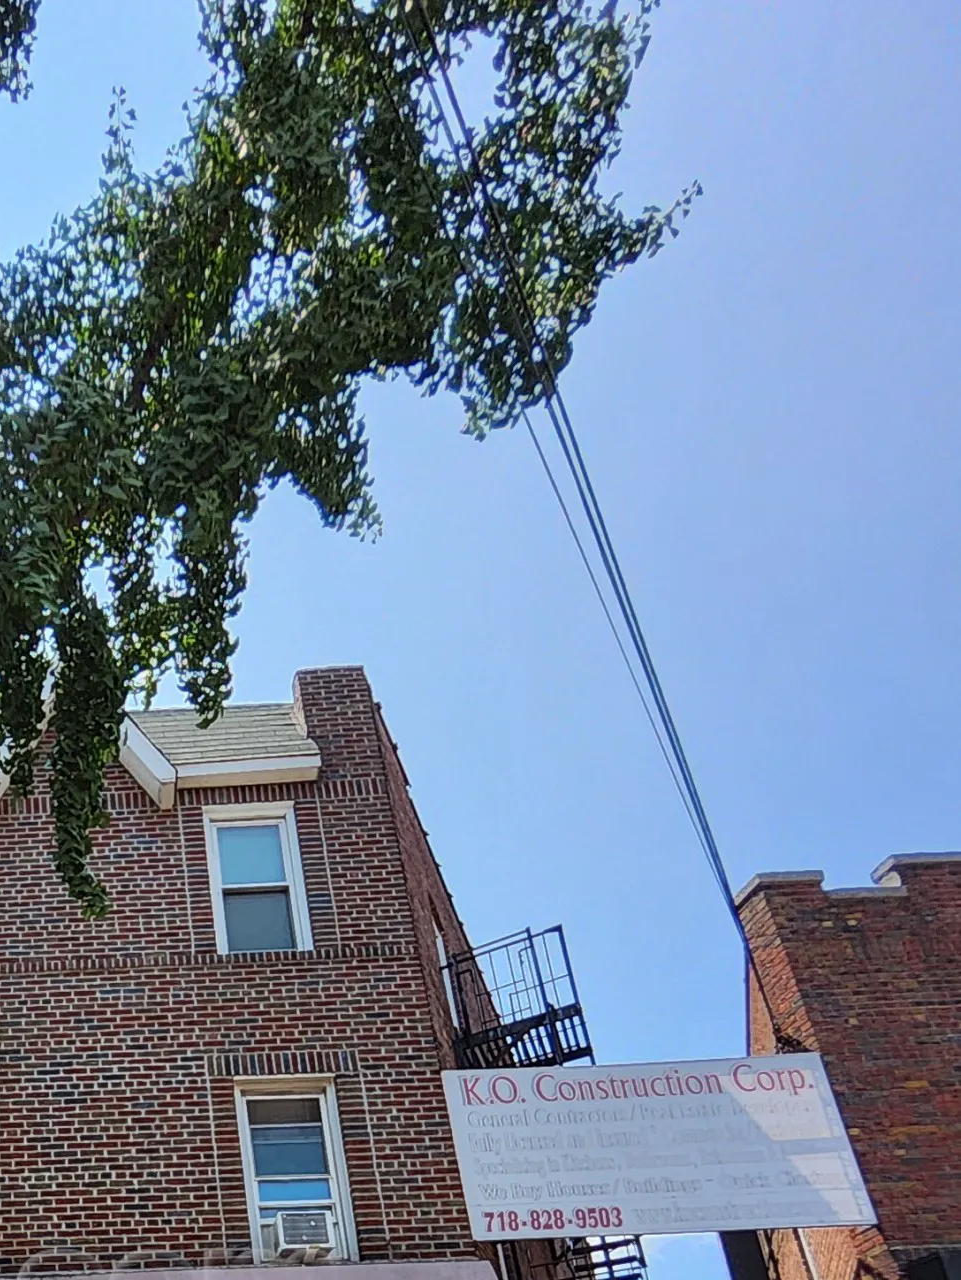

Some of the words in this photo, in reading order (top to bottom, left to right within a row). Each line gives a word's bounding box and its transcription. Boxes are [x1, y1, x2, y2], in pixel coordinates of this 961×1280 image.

[461, 1075, 527, 1106] K.O.
[535, 1069, 724, 1104] Construction
[732, 1063, 815, 1098] Corp.
[467, 1108, 531, 1128] General
[483, 1205, 624, 1232] 718-828-9503
